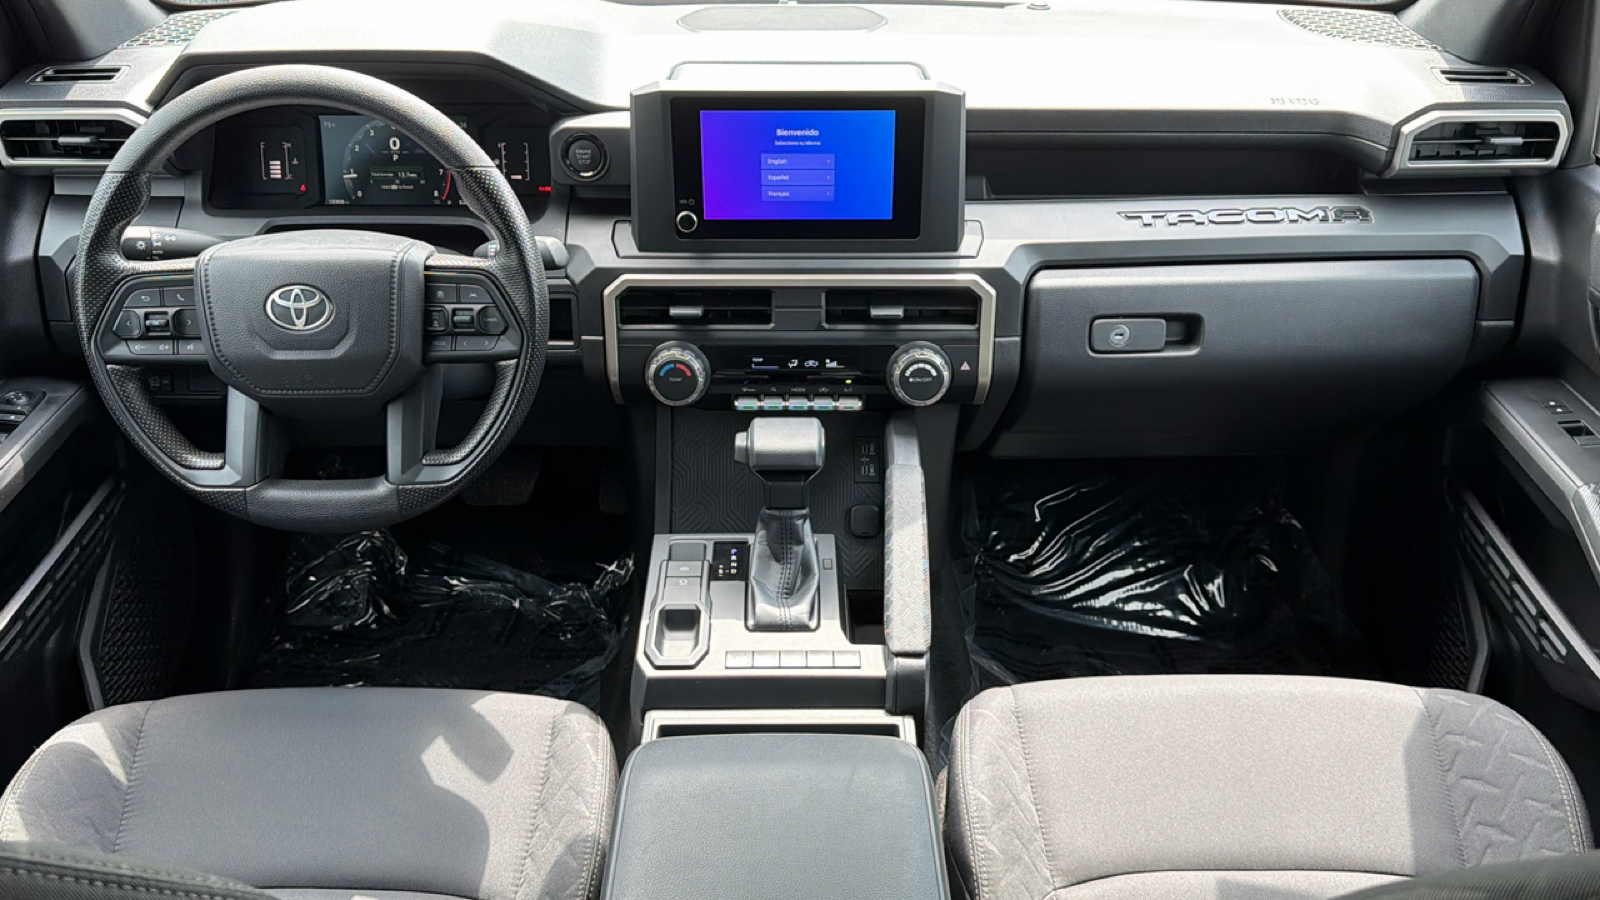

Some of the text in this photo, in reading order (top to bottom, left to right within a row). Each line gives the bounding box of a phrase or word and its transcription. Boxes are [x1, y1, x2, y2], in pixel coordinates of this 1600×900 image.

[776, 128, 820, 136] Bienvenido
[389, 136, 400, 150] 0
[768, 158, 787, 166] English
[1117, 205, 1373, 227] TACOMA
